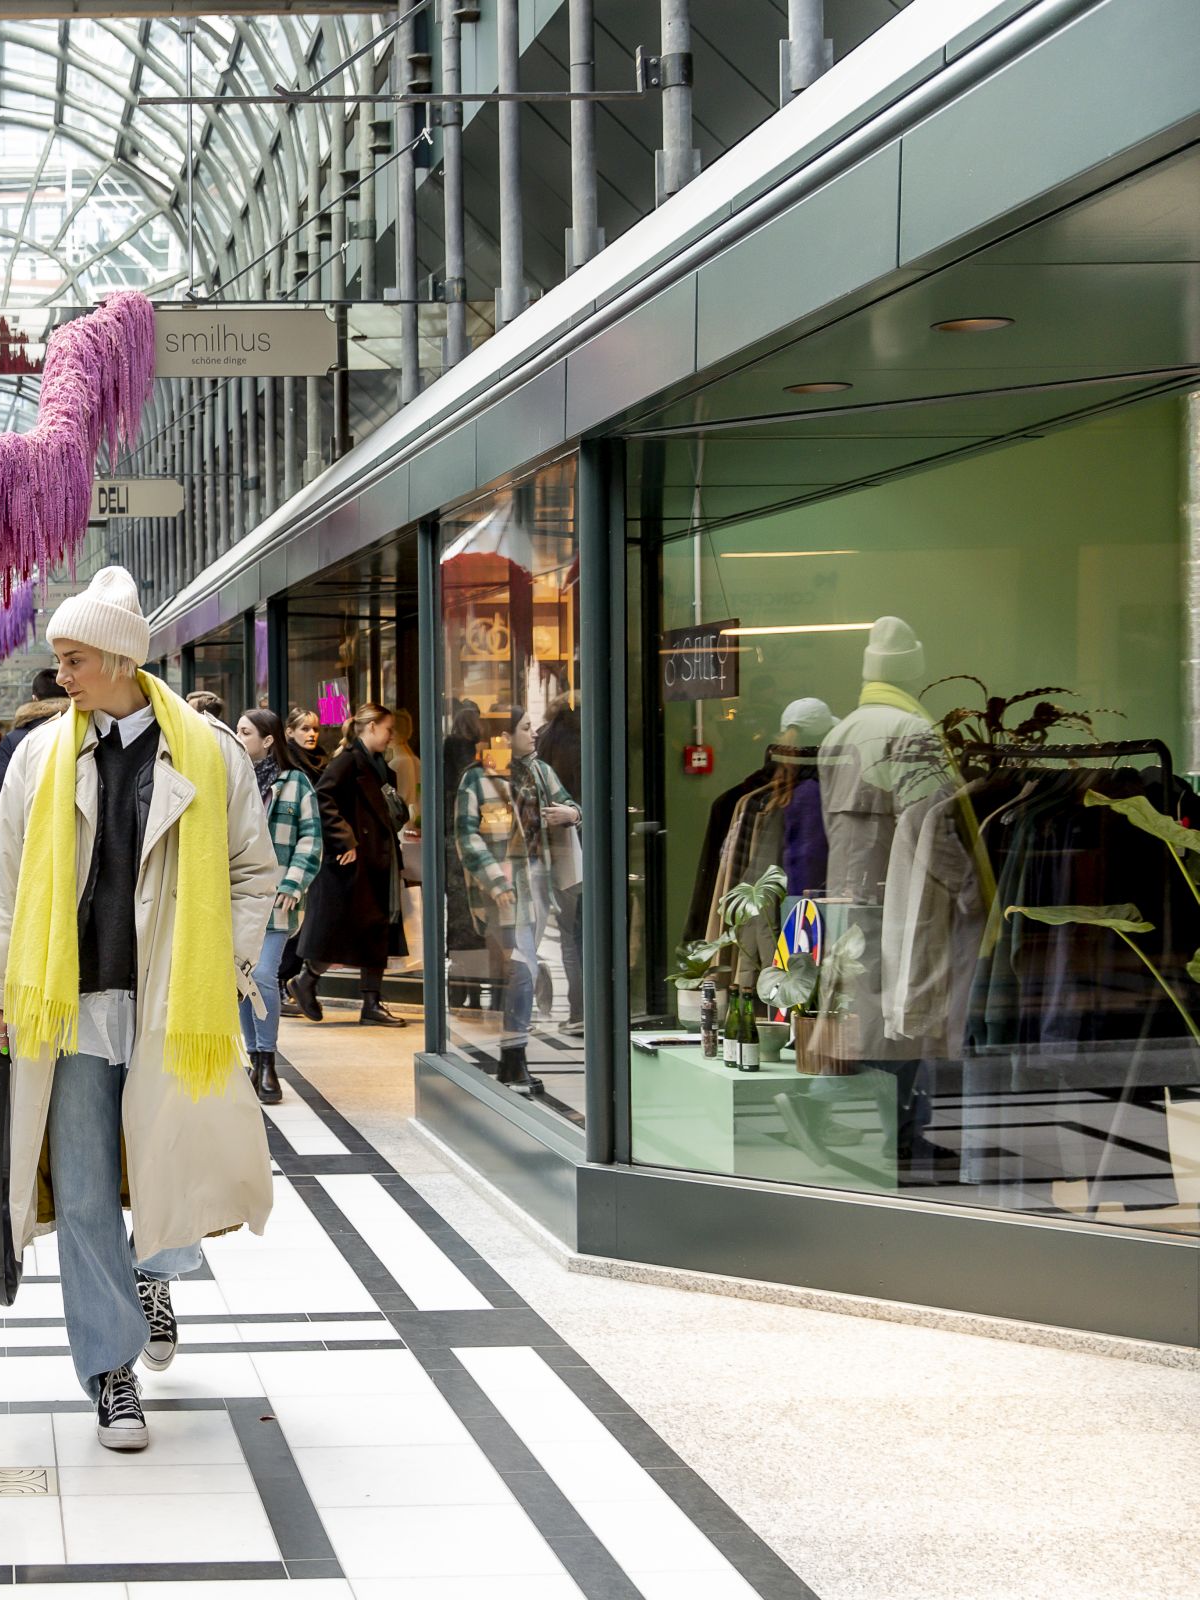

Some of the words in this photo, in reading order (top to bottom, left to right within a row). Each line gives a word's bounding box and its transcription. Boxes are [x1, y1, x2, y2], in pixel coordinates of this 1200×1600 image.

[165, 323, 271, 353] smilhus
[191, 356, 222, 365] schöne
[223, 356, 247, 366] dinge
[98, 487, 129, 515] DELI
[681, 634, 718, 681] SALE
